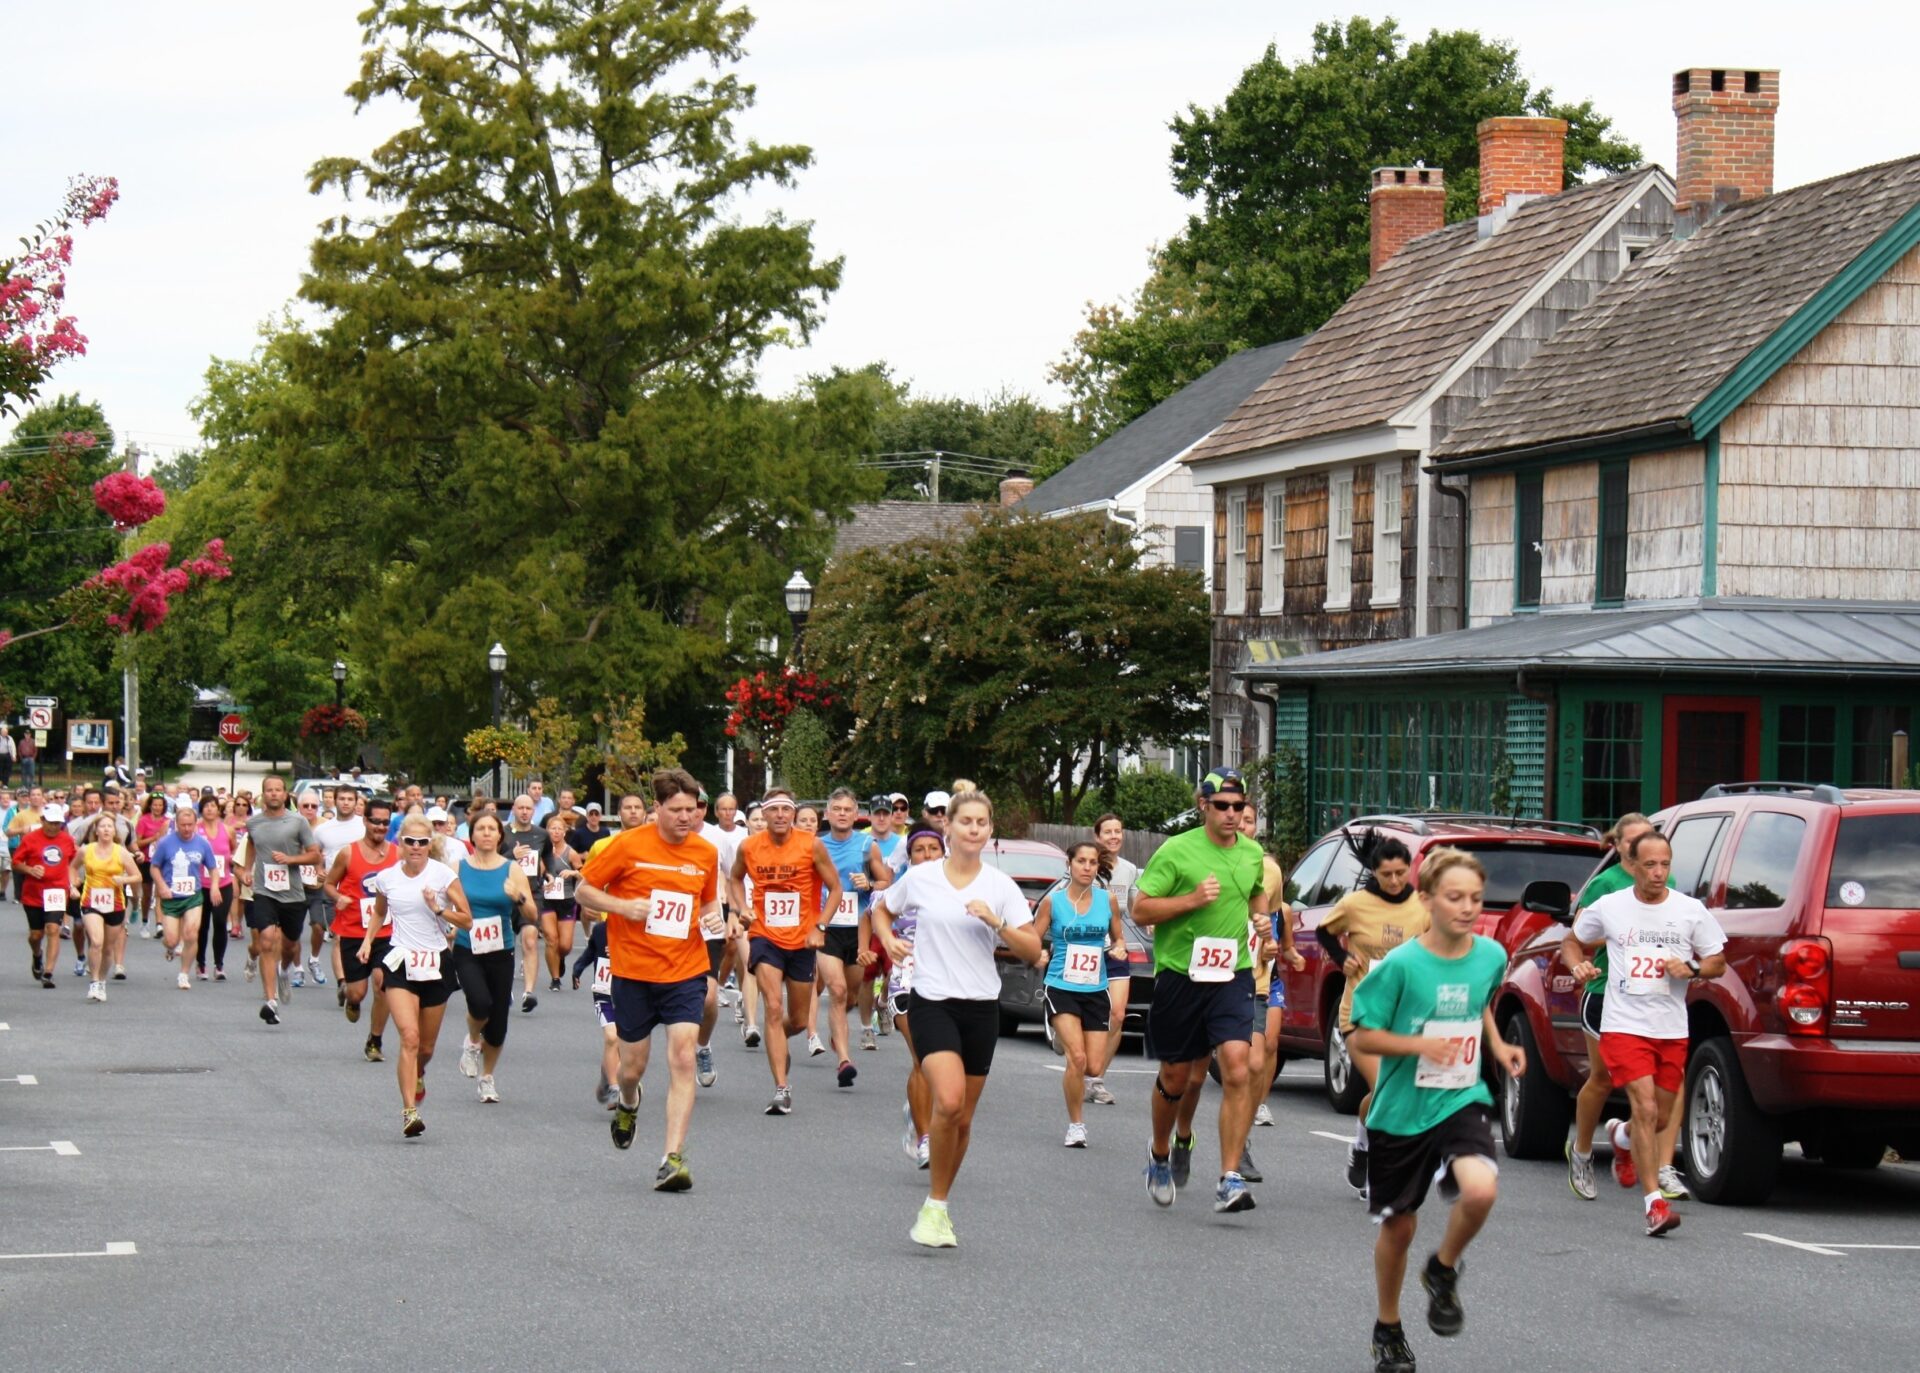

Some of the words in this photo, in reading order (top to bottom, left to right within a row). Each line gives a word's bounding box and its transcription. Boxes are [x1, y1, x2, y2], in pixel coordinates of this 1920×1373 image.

[221, 723, 241, 735] STO
[1564, 722, 1576, 788] 227
[267, 870, 287, 882] 452
[176, 881, 193, 892] 373
[94, 894, 112, 905] 442
[839, 900, 854, 914] 81
[654, 899, 687, 922] 370
[769, 900, 795, 916] 337
[474, 924, 499, 942] 443
[1639, 935, 1681, 945] BUSINESS
[410, 951, 436, 967] 371
[1071, 953, 1098, 972] 125
[1197, 947, 1233, 969] 352
[598, 966, 611, 983] 47
[1630, 956, 1666, 979] 229
[1835, 1000, 1910, 1010] DURANGO
